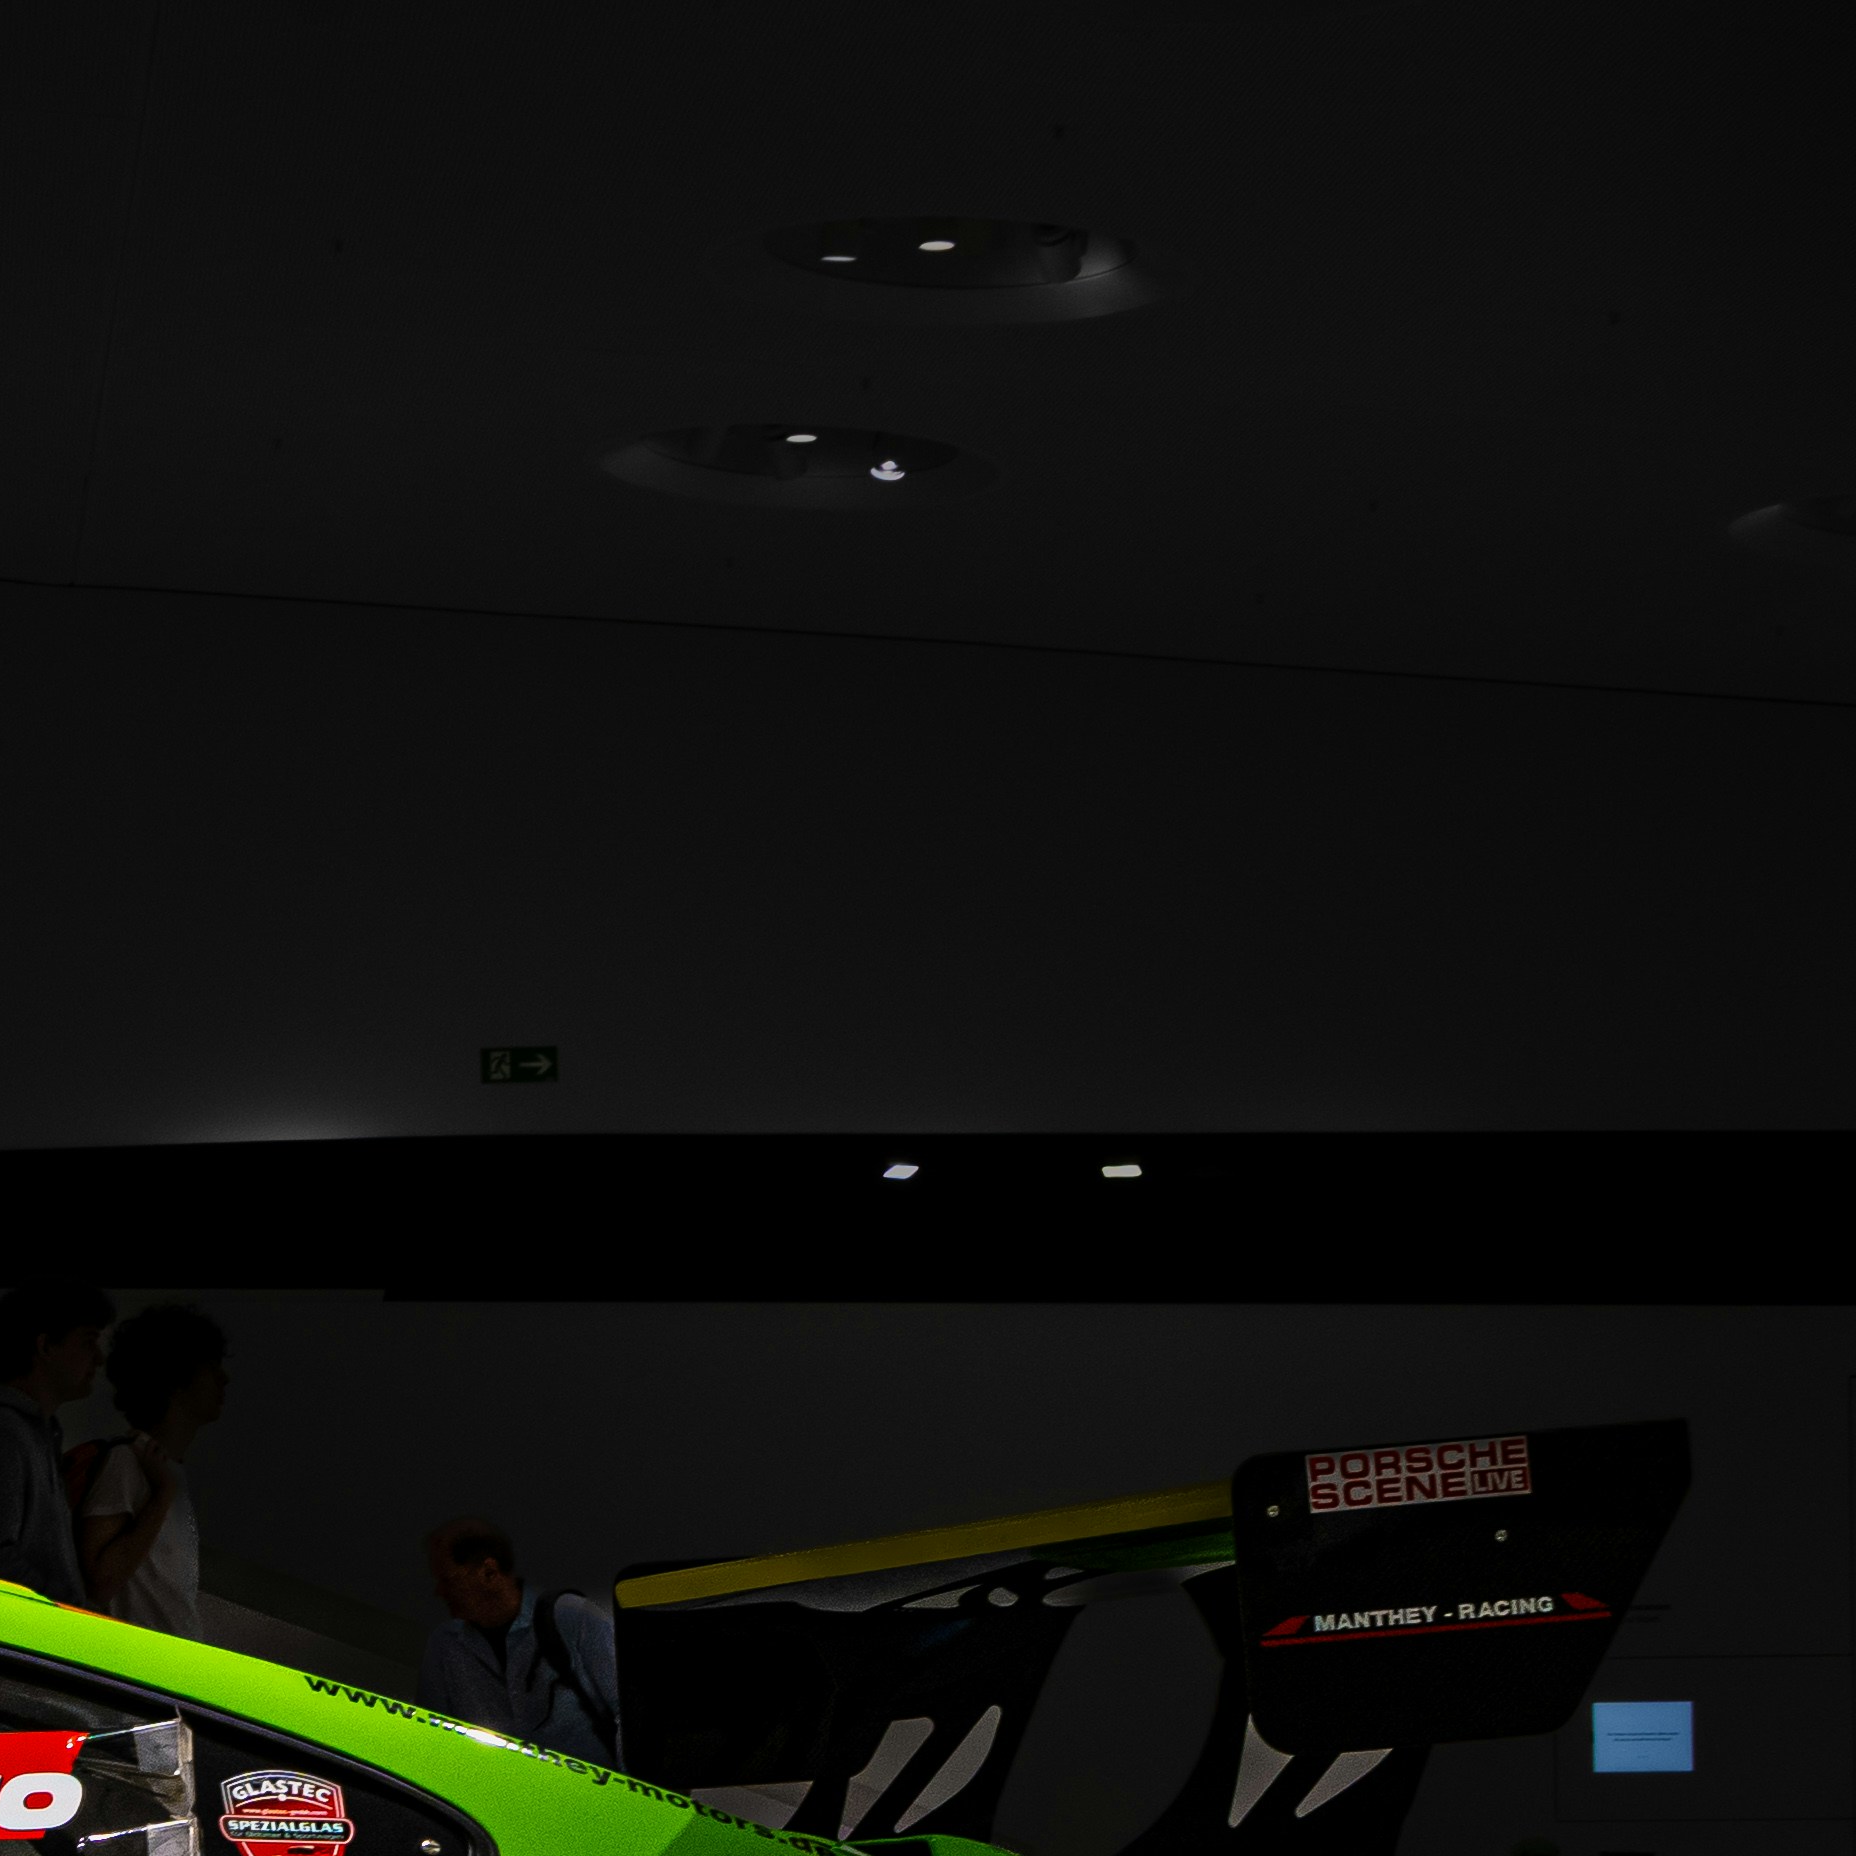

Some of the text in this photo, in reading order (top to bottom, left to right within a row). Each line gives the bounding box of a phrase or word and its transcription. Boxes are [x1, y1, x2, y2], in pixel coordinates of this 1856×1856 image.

[1309, 1438, 1528, 1483] PORSCHE
[1310, 1468, 1527, 1511] SCENE LIVE
[1314, 1605, 1438, 1632] MANTHEY
[1457, 1596, 1553, 1620] RACING
[231, 1779, 332, 1803] GLASTEC
[227, 1819, 344, 1833] SPEZIALGLAS
